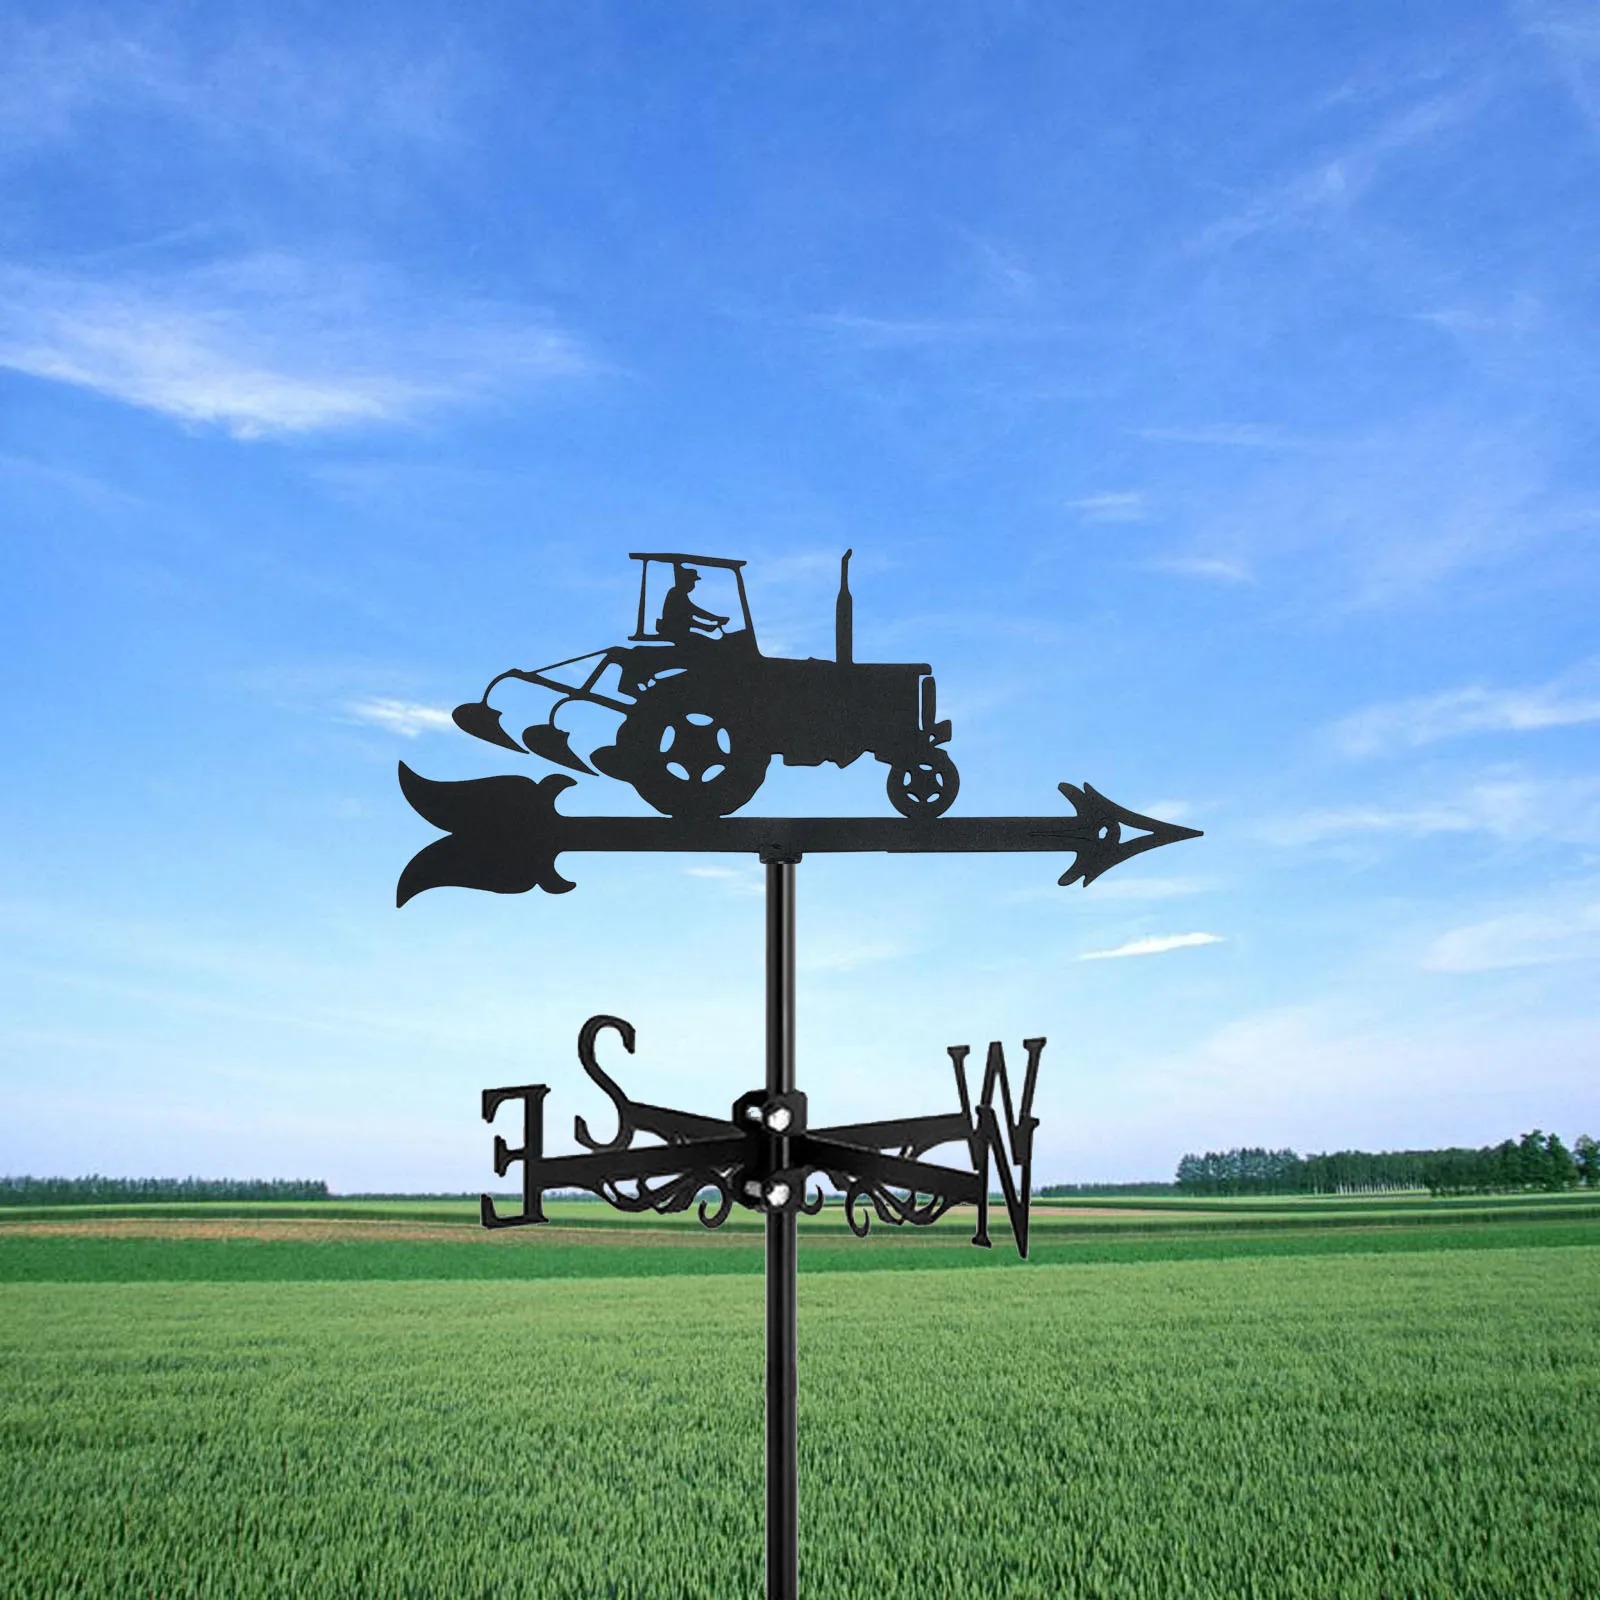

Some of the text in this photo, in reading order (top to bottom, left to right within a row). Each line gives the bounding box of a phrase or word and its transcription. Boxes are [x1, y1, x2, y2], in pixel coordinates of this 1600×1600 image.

[574, 1014, 636, 1151] S
[947, 1037, 1047, 1171] W
[971, 1105, 1040, 1260] N
